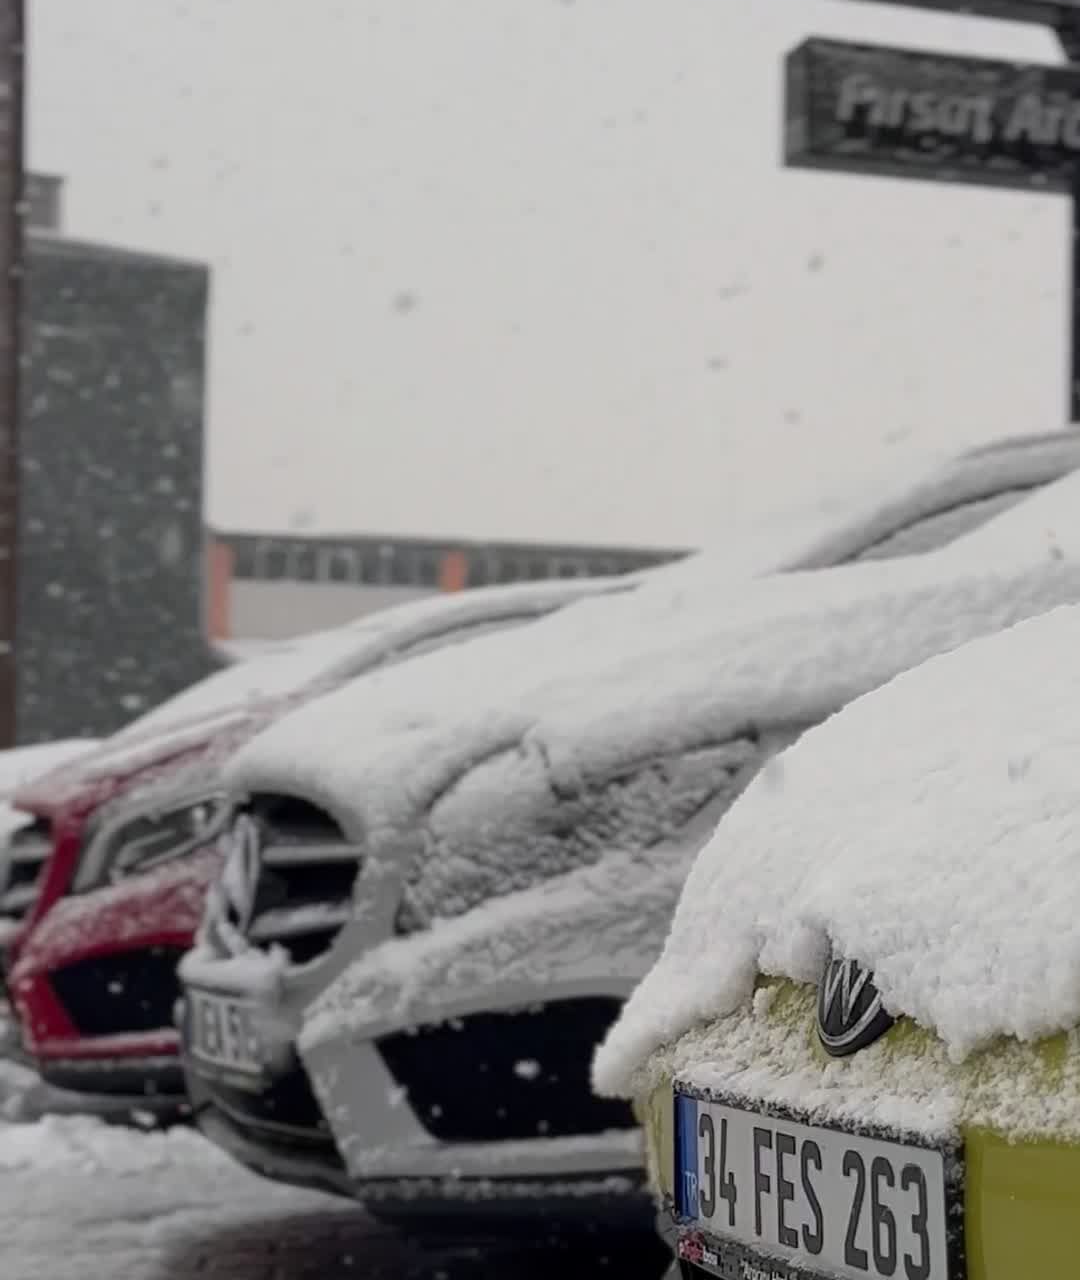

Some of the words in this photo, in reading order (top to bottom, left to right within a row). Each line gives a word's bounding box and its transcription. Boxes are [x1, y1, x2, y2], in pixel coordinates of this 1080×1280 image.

[682, 1170, 698, 1201] TR
[700, 1113, 737, 1227] 34
[753, 1126, 824, 1255] FES
